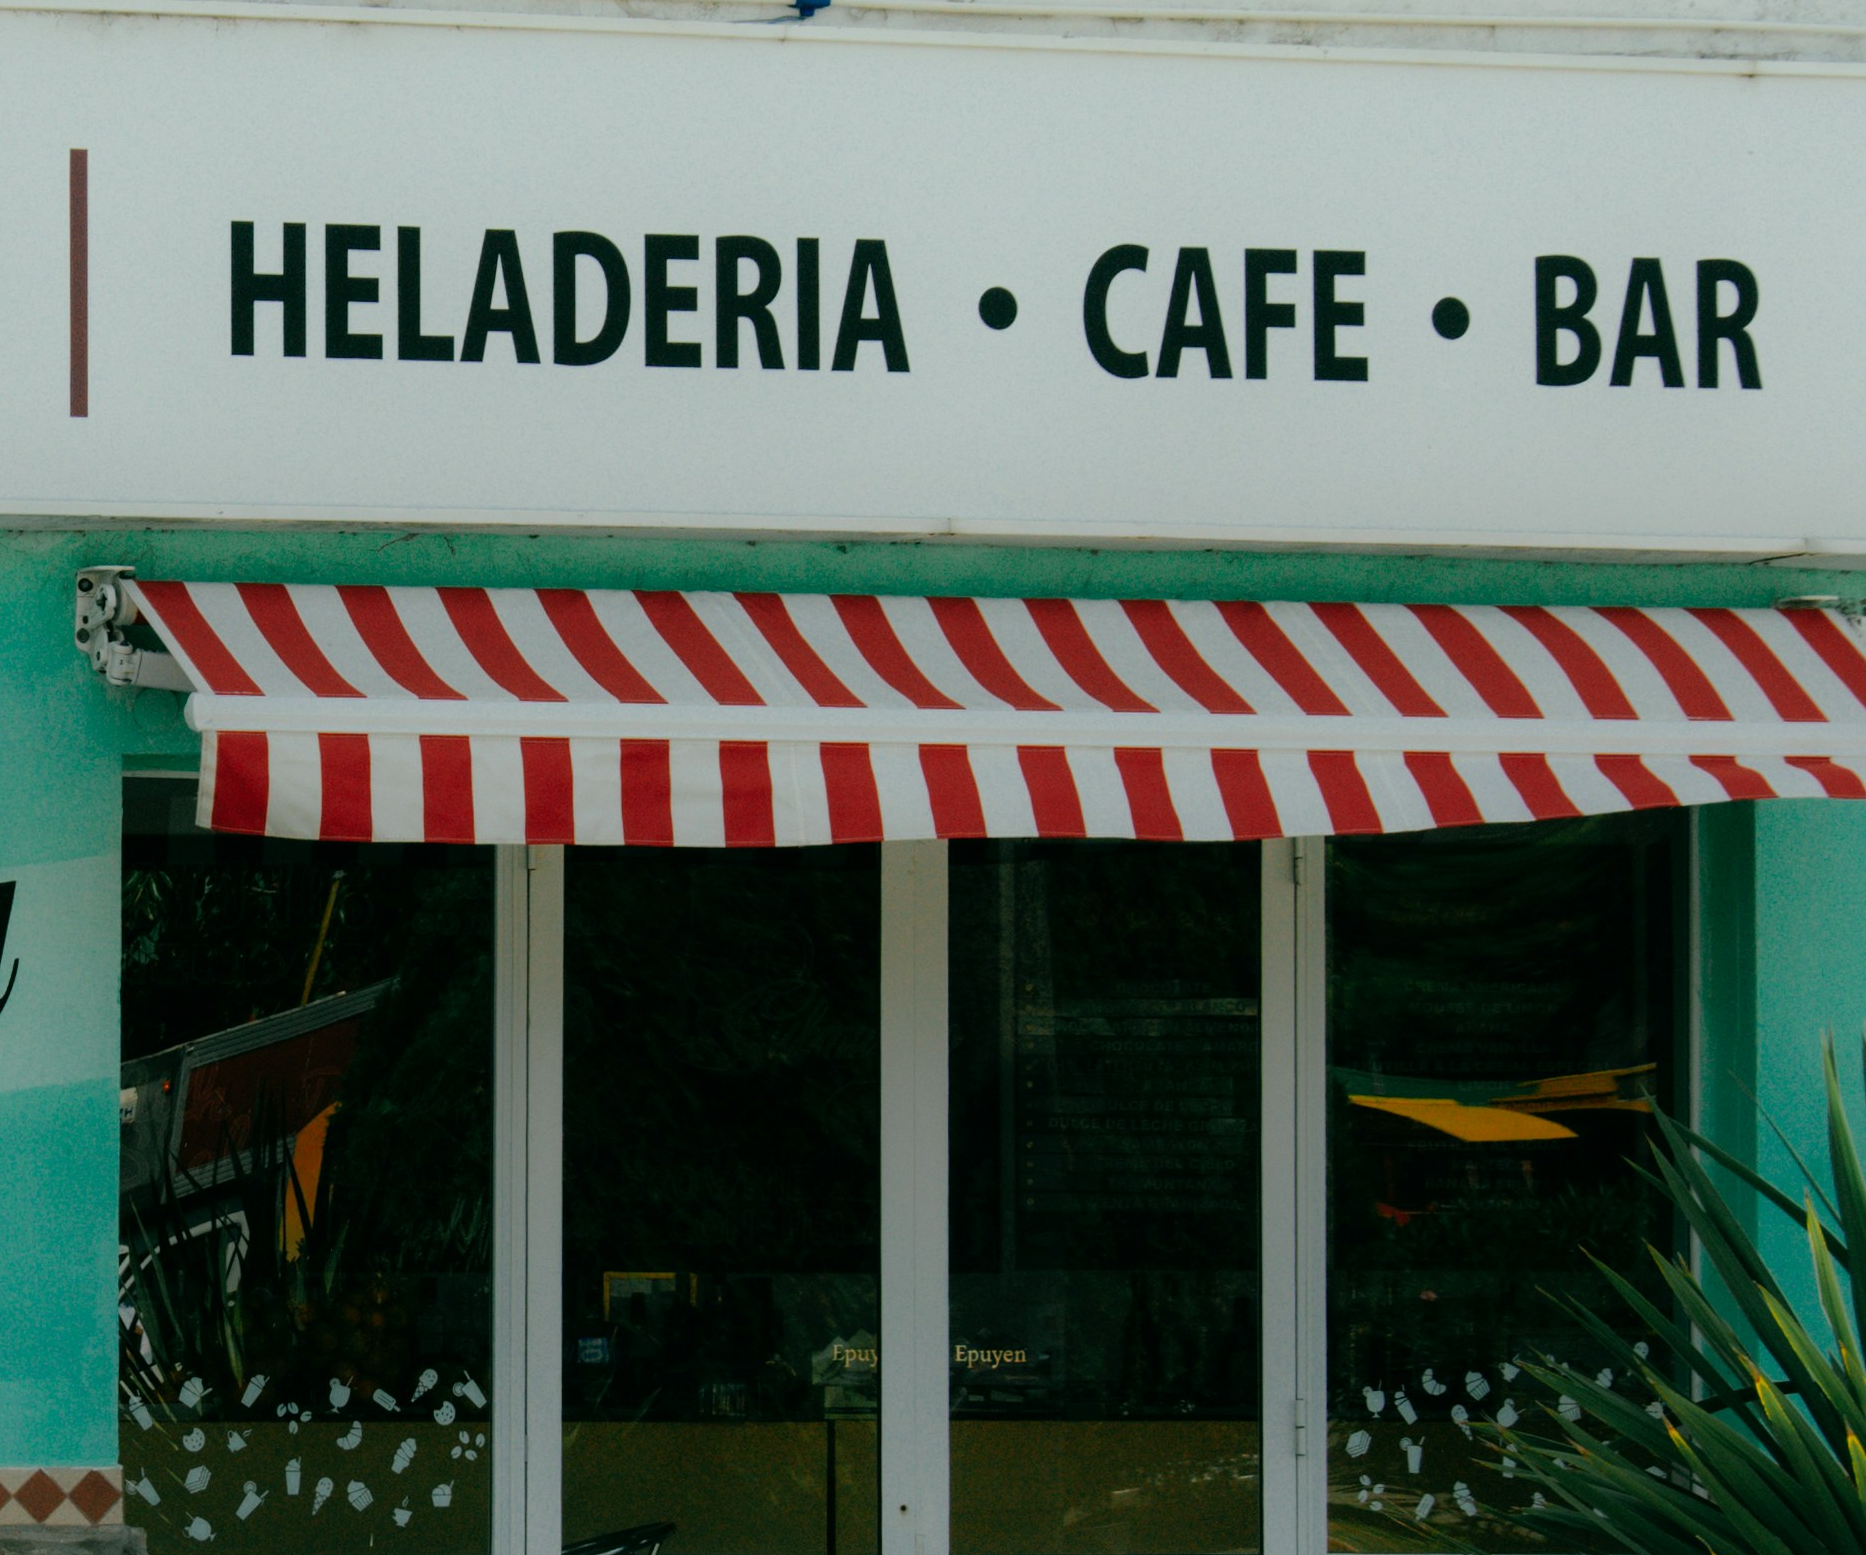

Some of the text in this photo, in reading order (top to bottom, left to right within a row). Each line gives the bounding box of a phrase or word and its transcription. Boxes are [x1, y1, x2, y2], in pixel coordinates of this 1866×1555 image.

[229, 220, 1765, 391] HELADERIA CAFE BAR
[953, 1344, 1027, 1369] Epuyen
